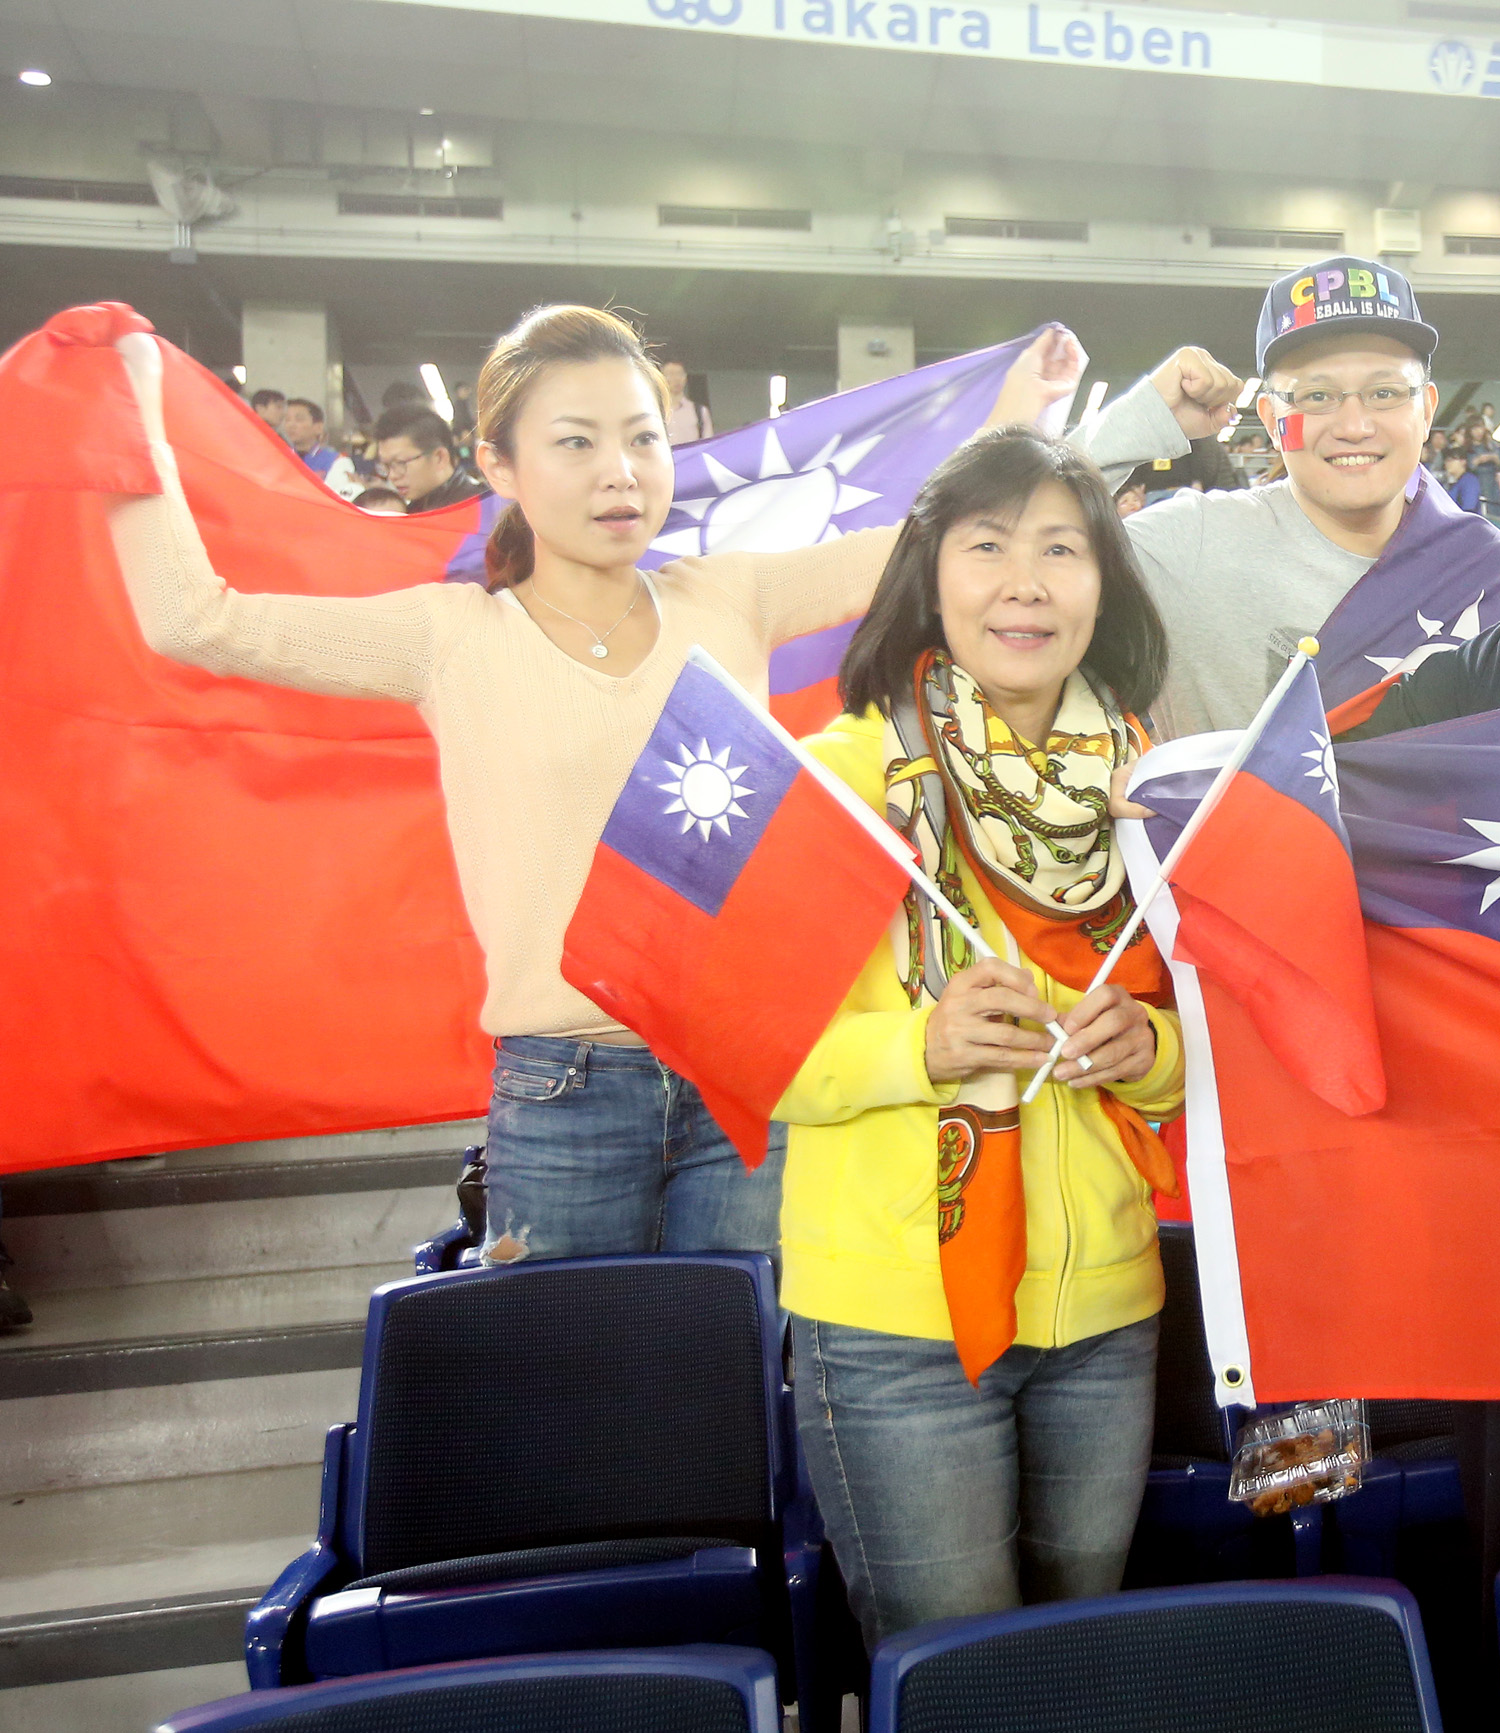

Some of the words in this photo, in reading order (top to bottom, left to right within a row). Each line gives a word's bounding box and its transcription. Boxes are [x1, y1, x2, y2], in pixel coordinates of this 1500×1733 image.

[1027, 3, 1213, 69] Leben
[1290, 268, 1399, 307] CPBL
[1313, 300, 1358, 321] EBALL
[1361, 301, 1374, 316] IS
